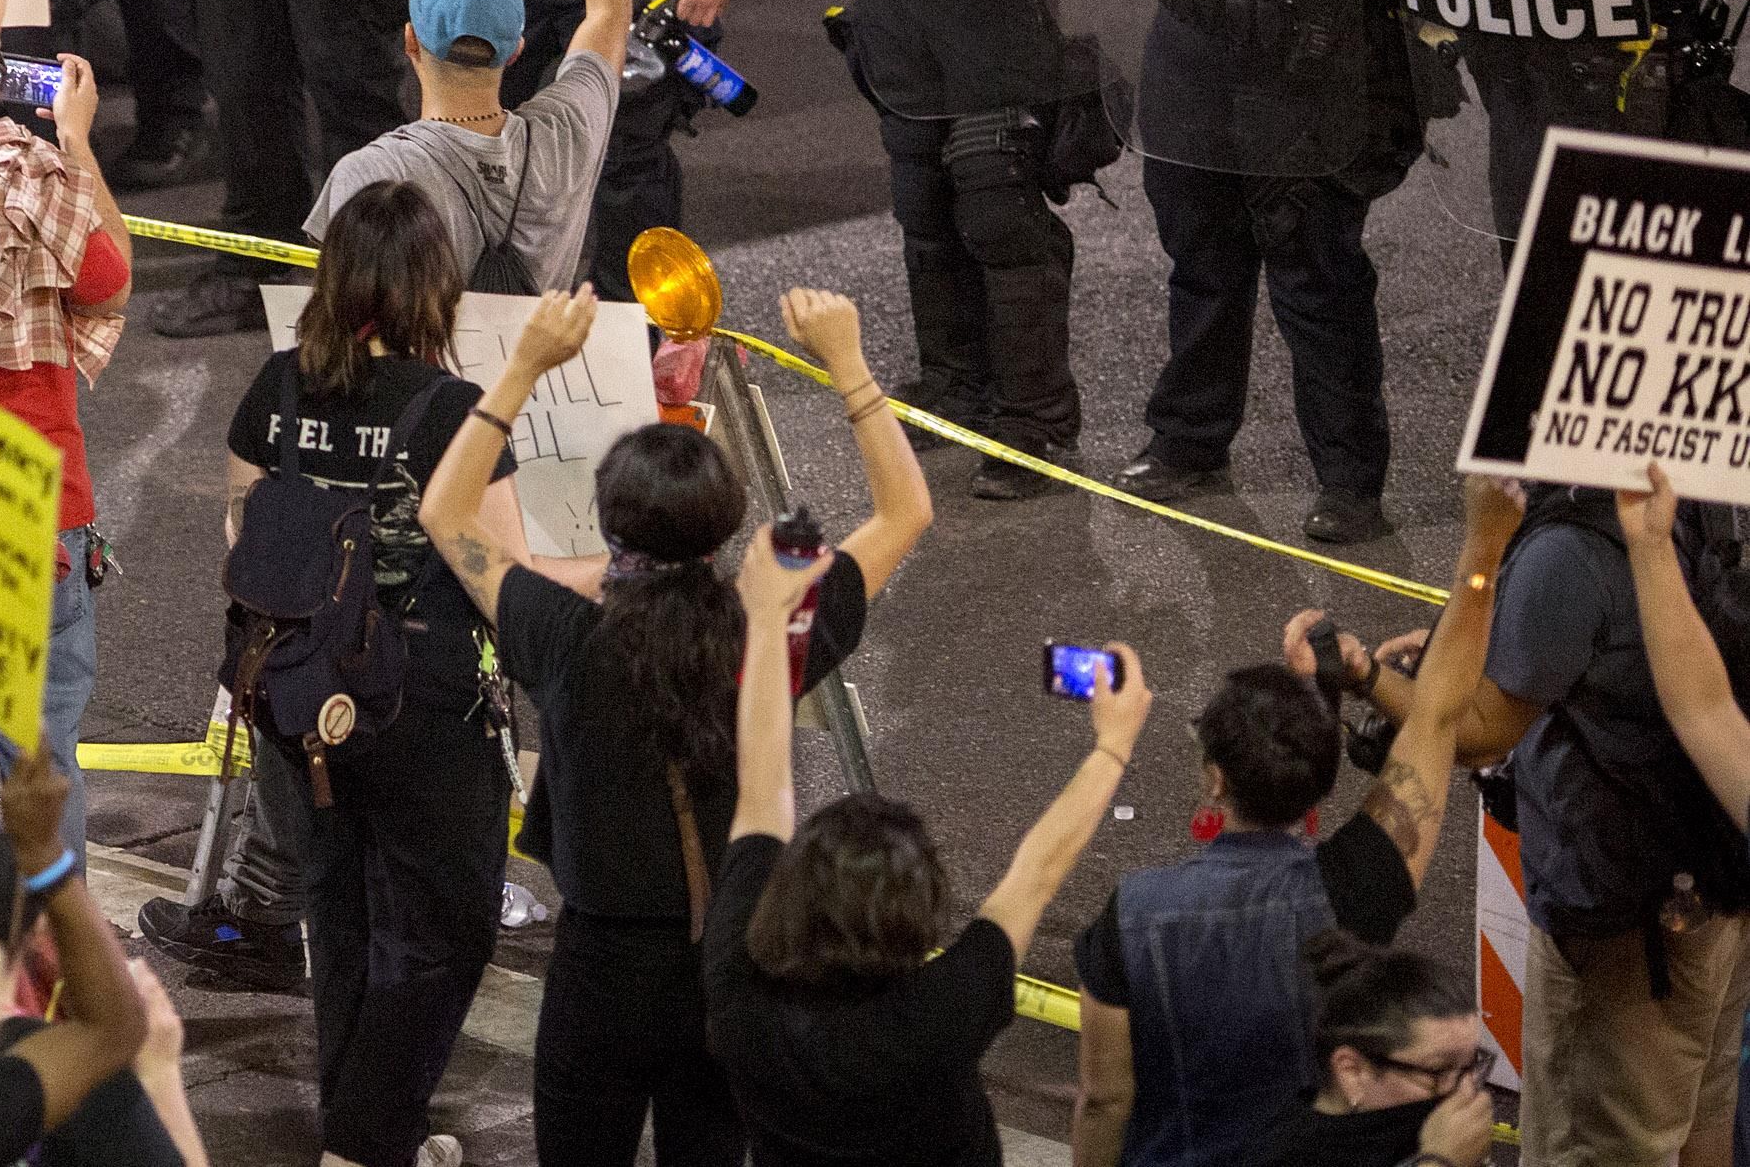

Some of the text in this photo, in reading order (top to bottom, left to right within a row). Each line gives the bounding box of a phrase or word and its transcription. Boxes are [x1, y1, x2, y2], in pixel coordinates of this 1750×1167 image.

[1570, 193, 1750, 265] BLACK L
[1580, 275, 1750, 351] NO TRU
[1557, 339, 1750, 426] NO KK
[266, 413, 409, 460] FEL TH
[1544, 410, 1750, 468] NO FASCIST U
